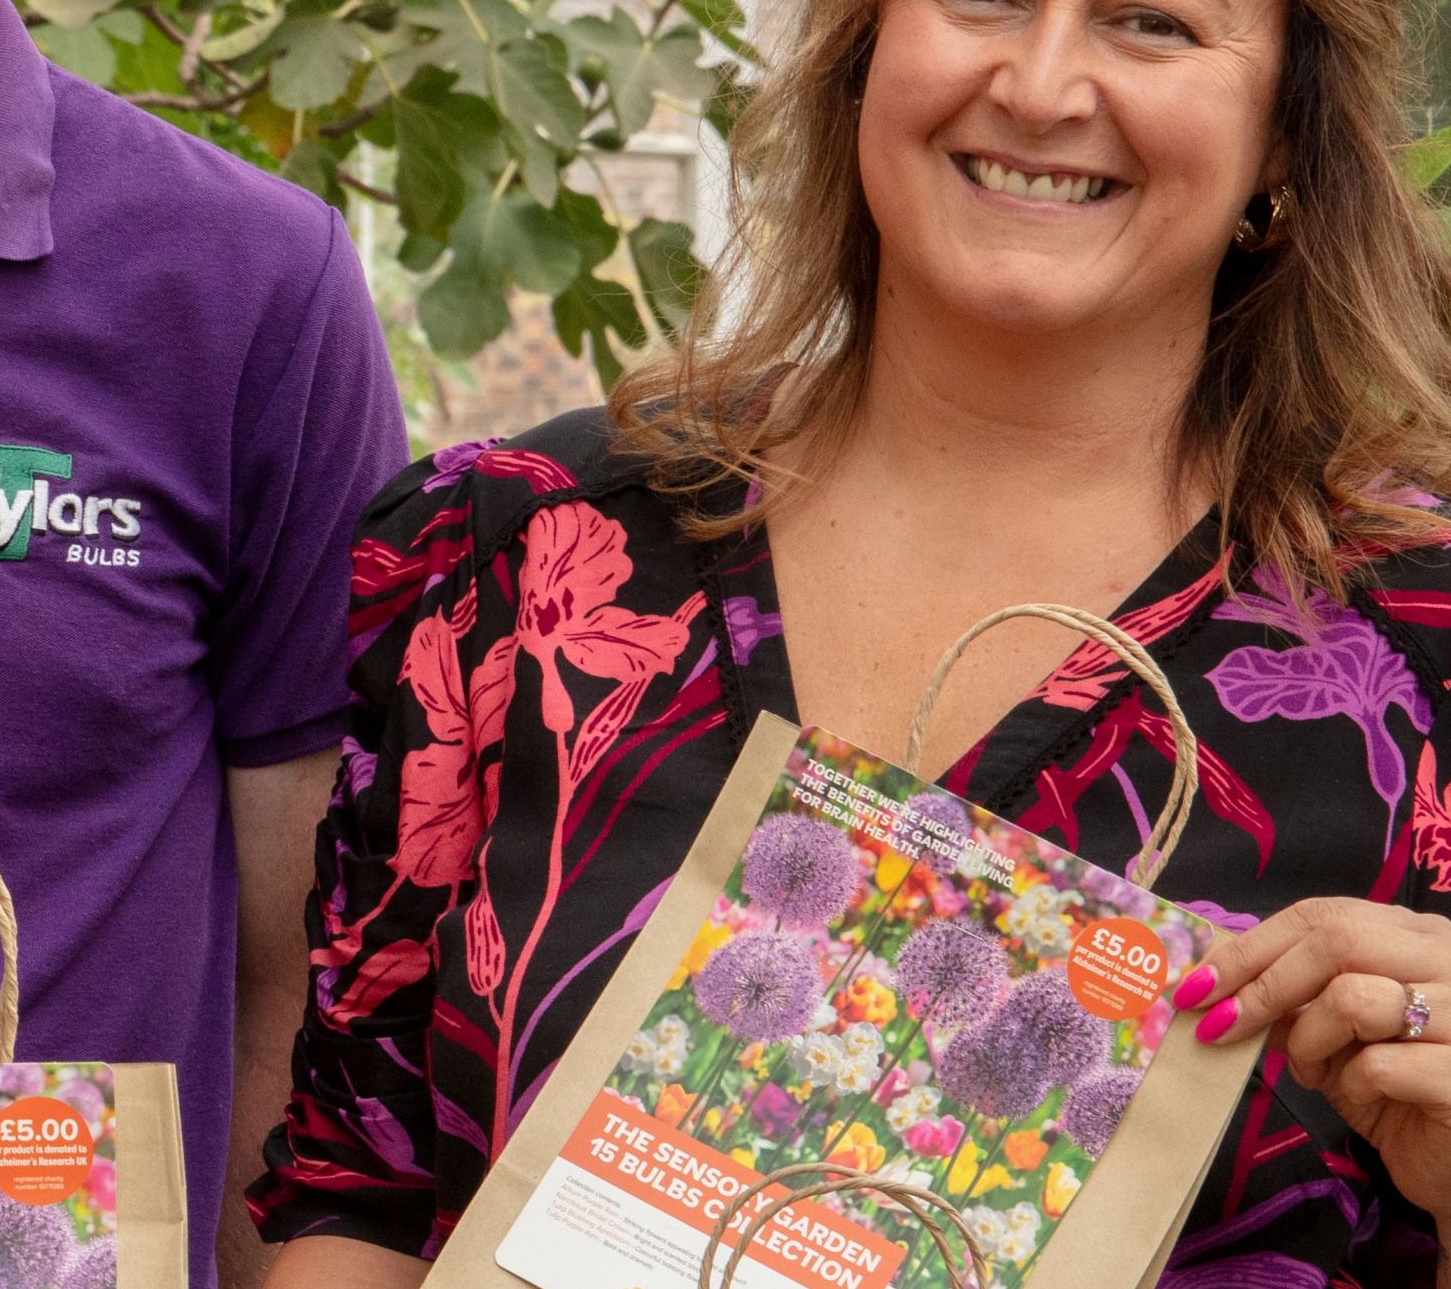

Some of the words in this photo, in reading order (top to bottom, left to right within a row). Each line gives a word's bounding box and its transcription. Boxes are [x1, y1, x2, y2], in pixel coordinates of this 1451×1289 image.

[66, 544, 140, 567] BULBS
[791, 785, 823, 809] FOR
[820, 800, 864, 830] BRAIN
[863, 822, 922, 860] HEALTH.
[798, 772, 828, 794] THE
[826, 786, 892, 827] BENEFITS
[890, 818, 910, 836] OF
[910, 829, 970, 867] GARDEN
[969, 858, 1015, 890] LIVING
[805, 758, 878, 802] TOGETHER
[876, 794, 920, 824] WE'RE
[918, 815, 1016, 873] HIGHLIGHTING
[1089, 925, 1163, 977] £5.00
[0, 1118, 78, 1141] £5.00
[3, 1145, 33, 1155] product
[35, 1144, 42, 1153] is
[44, 1144, 76, 1153] donated
[78, 1144, 87, 1153] to
[38, 1157, 74, 1166] Research
[76, 1157, 87, 1165] UK
[584, 1134, 621, 1165] 15
[616, 1151, 705, 1210] BULBS
[598, 1112, 655, 1154] THE
[769, 1202, 882, 1273] GARDEN
